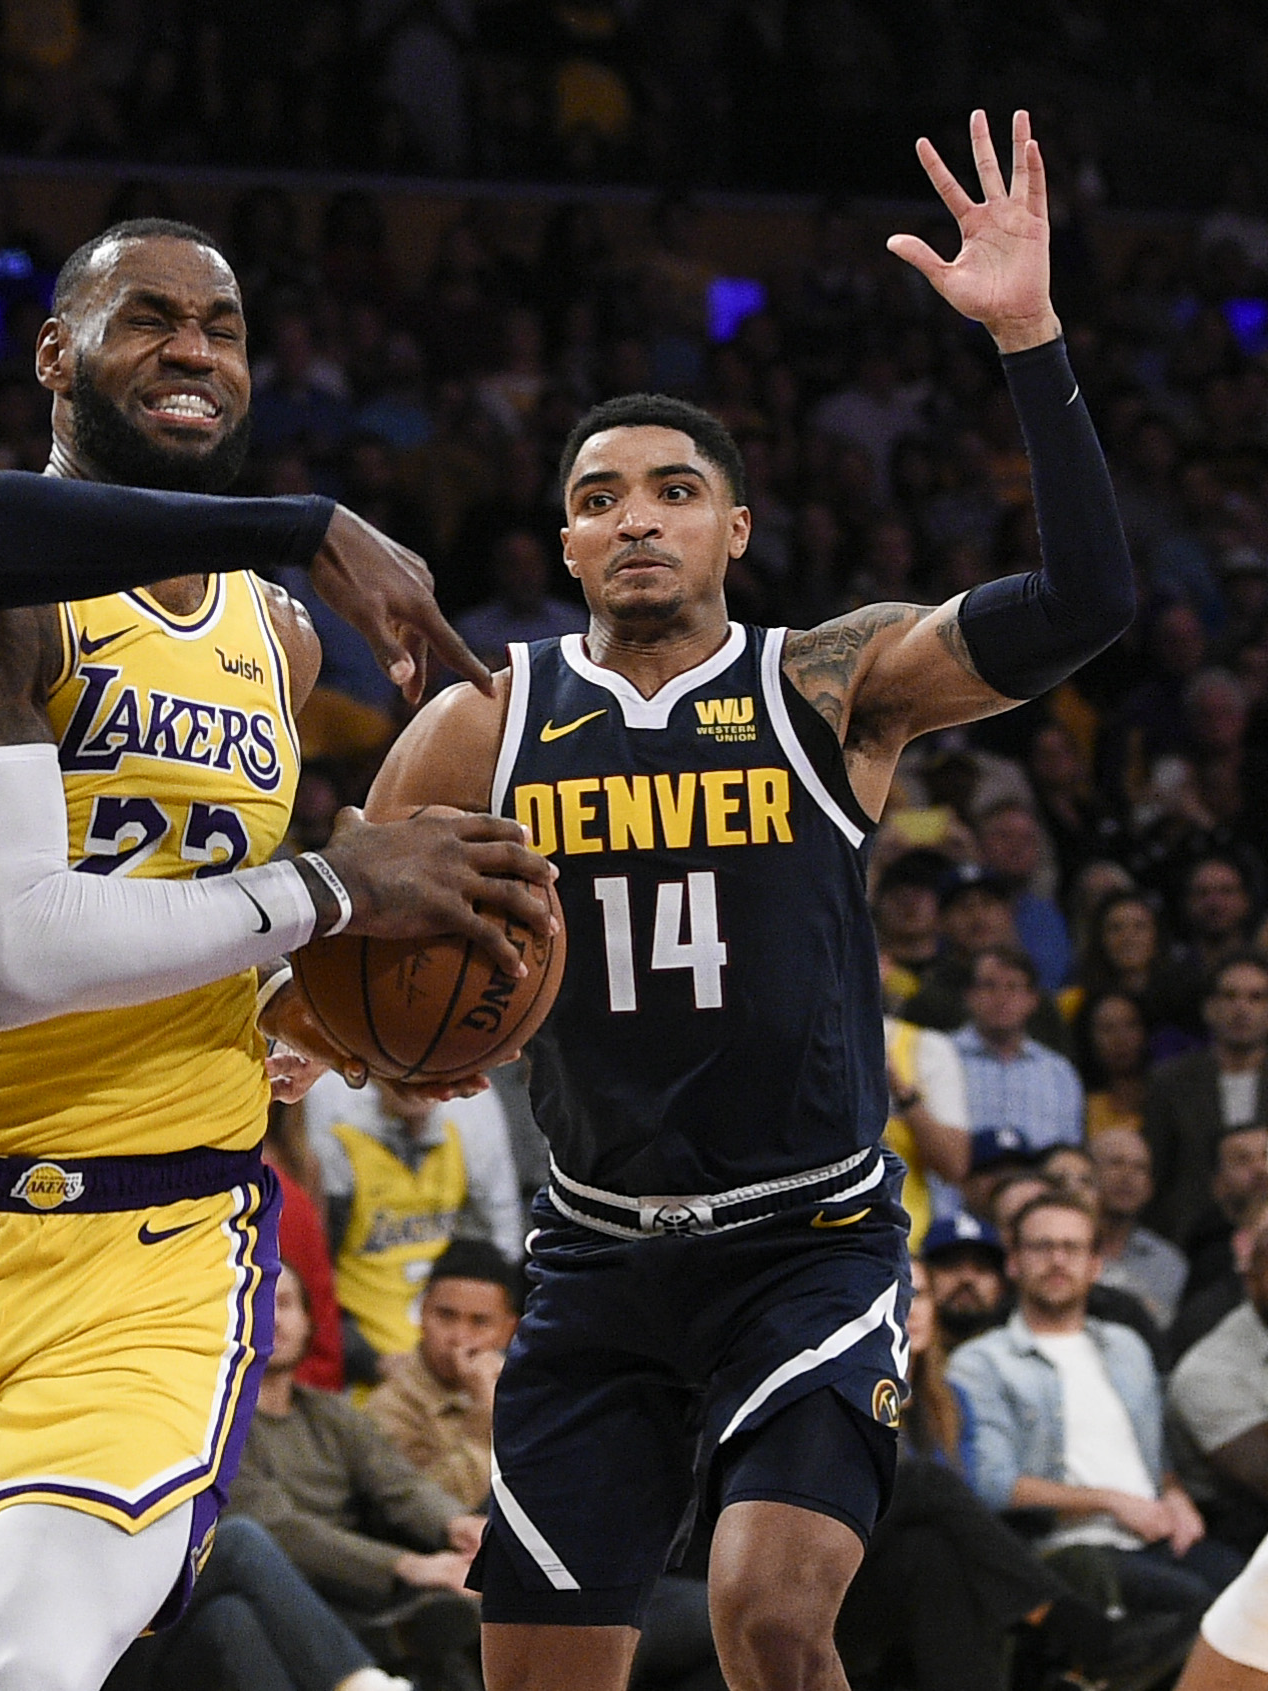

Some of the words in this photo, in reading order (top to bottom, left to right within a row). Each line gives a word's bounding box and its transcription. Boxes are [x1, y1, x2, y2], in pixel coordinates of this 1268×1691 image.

[214, 646, 265, 685] wish
[58, 663, 282, 794] LAKERS
[694, 696, 754, 725] WU
[696, 725, 756, 735] WESTERN
[714, 733, 757, 743] UNION
[514, 767, 794, 858] DENVER
[593, 870, 728, 1013] 14
